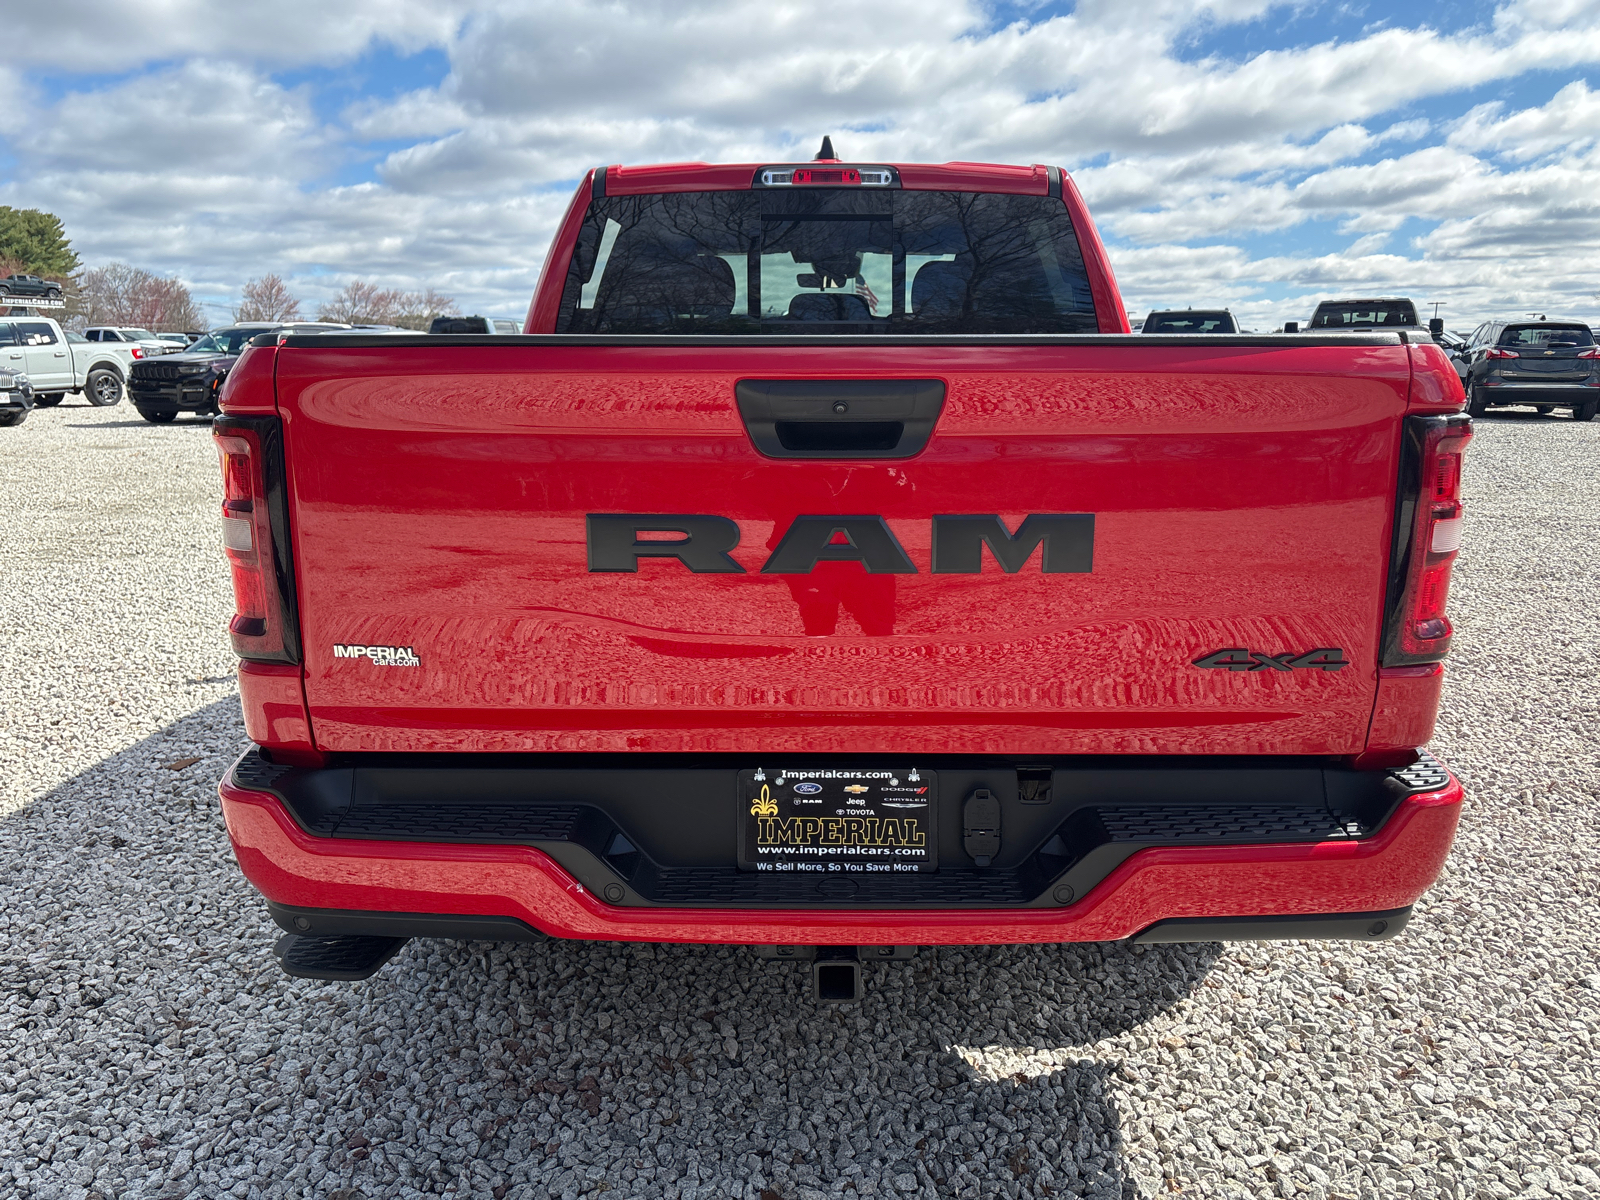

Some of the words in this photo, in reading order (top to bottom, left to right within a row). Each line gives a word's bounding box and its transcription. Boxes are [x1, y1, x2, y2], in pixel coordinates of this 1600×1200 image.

[586, 513, 1095, 573] RAM
[333, 645, 419, 660] IMPERIAL
[372, 658, 419, 667] cars.com
[781, 769, 893, 780] Imperialcars.com
[799, 784, 816, 792] Ford
[846, 798, 866, 807] Jeep
[757, 816, 926, 847] IMPERIAL
[757, 845, 926, 856] www.imperialcars.com
[756, 862, 773, 871] We
[775, 862, 794, 871] Sell
[797, 863, 825, 873] More,
[828, 863, 841, 871] So
[844, 863, 863, 872] You
[865, 863, 891, 872] Save
[893, 863, 919, 872] More
